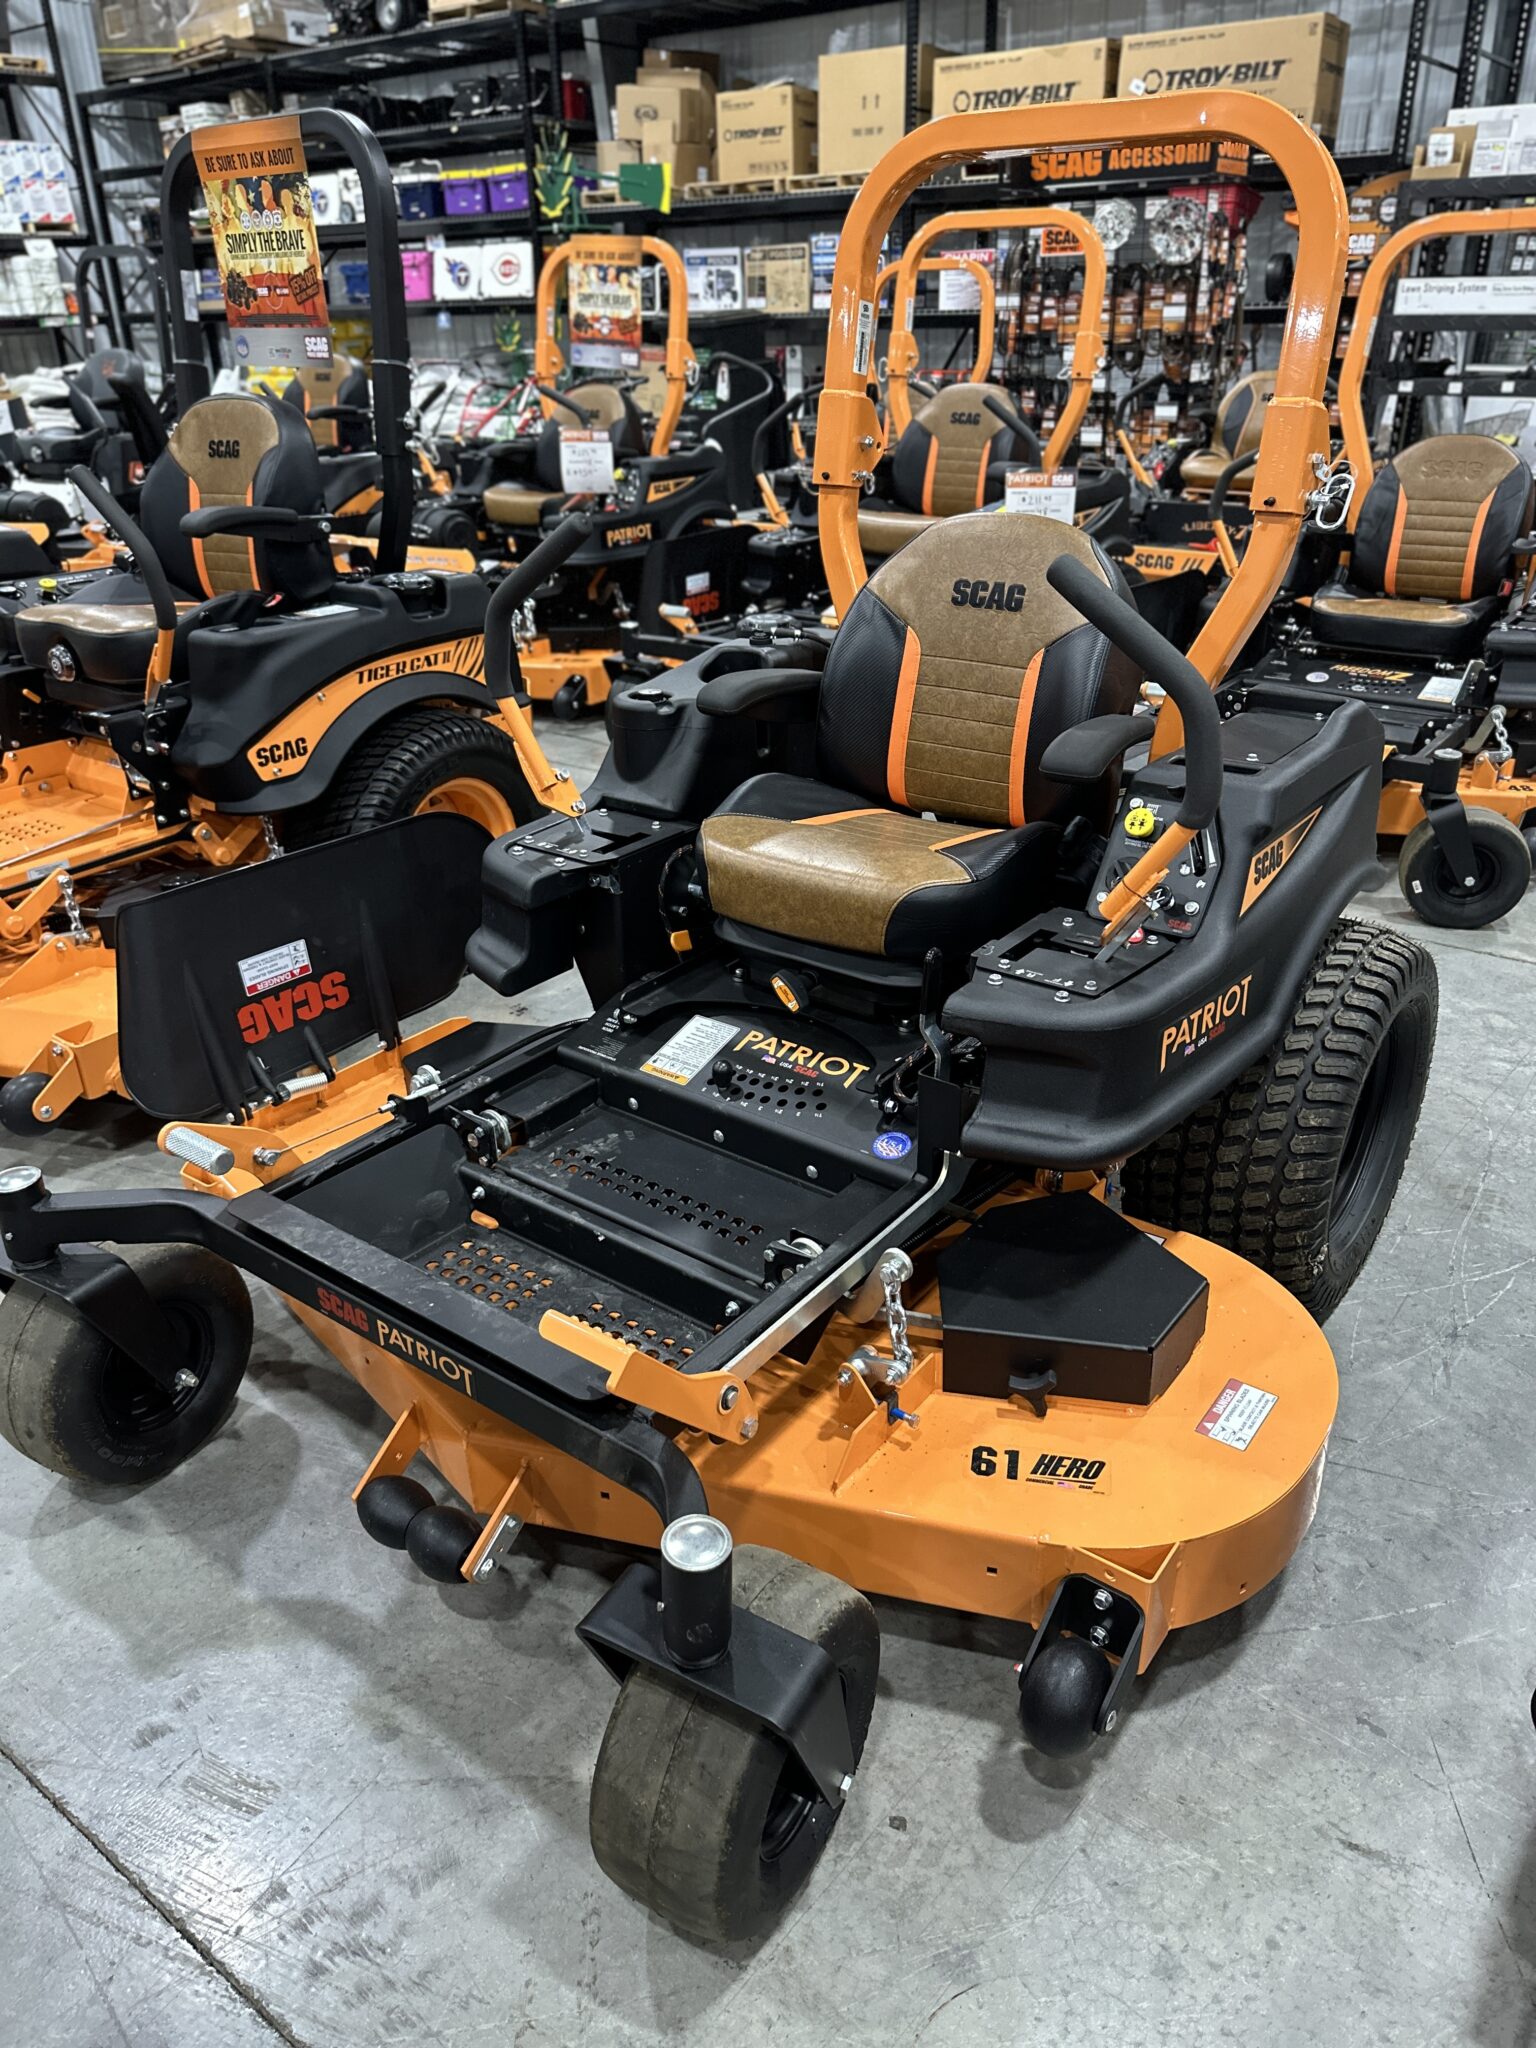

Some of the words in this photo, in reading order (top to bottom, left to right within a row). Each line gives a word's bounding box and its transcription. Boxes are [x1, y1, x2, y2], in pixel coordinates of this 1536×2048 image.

[1165, 58, 1287, 92] TROY-BILT
[972, 81, 1078, 112] TROY-BILT
[733, 125, 785, 140] TROY-BILT
[204, 156, 216, 173] BE
[216, 154, 238, 171] SURE
[236, 152, 249, 169] TO
[249, 150, 265, 168] ASK
[267, 147, 295, 166] ABOUT
[1423, 282, 1455, 296] Striping
[305, 337, 328, 352] SCAG
[951, 411, 981, 425] SCAG
[208, 439, 240, 459] SCAG
[606, 523, 652, 548] PATRIOT
[1136, 552, 1175, 570] SCAG
[951, 578, 1027, 613] SCAG
[356, 660, 407, 685] TIGER
[410, 652, 439, 672] CAT
[1329, 664, 1393, 676] FREEDOM
[256, 737, 309, 768] SCAG
[1253, 840, 1284, 886] SCAG
[1168, 918, 1192, 931] SCAG
[256, 971, 291, 990] DANGER
[237, 971, 350, 1044] SCAG
[1161, 974, 1253, 1074] PATRIOT
[733, 1030, 870, 1090] PATRIOT
[793, 1065, 820, 1078] SCAG
[316, 1287, 369, 1332] SCAG
[376, 1319, 473, 1397] PATRIOT
[1211, 1388, 1236, 1414] DANGER
[970, 1445, 1020, 1480] 61
[1030, 1453, 1106, 1480] HERO
